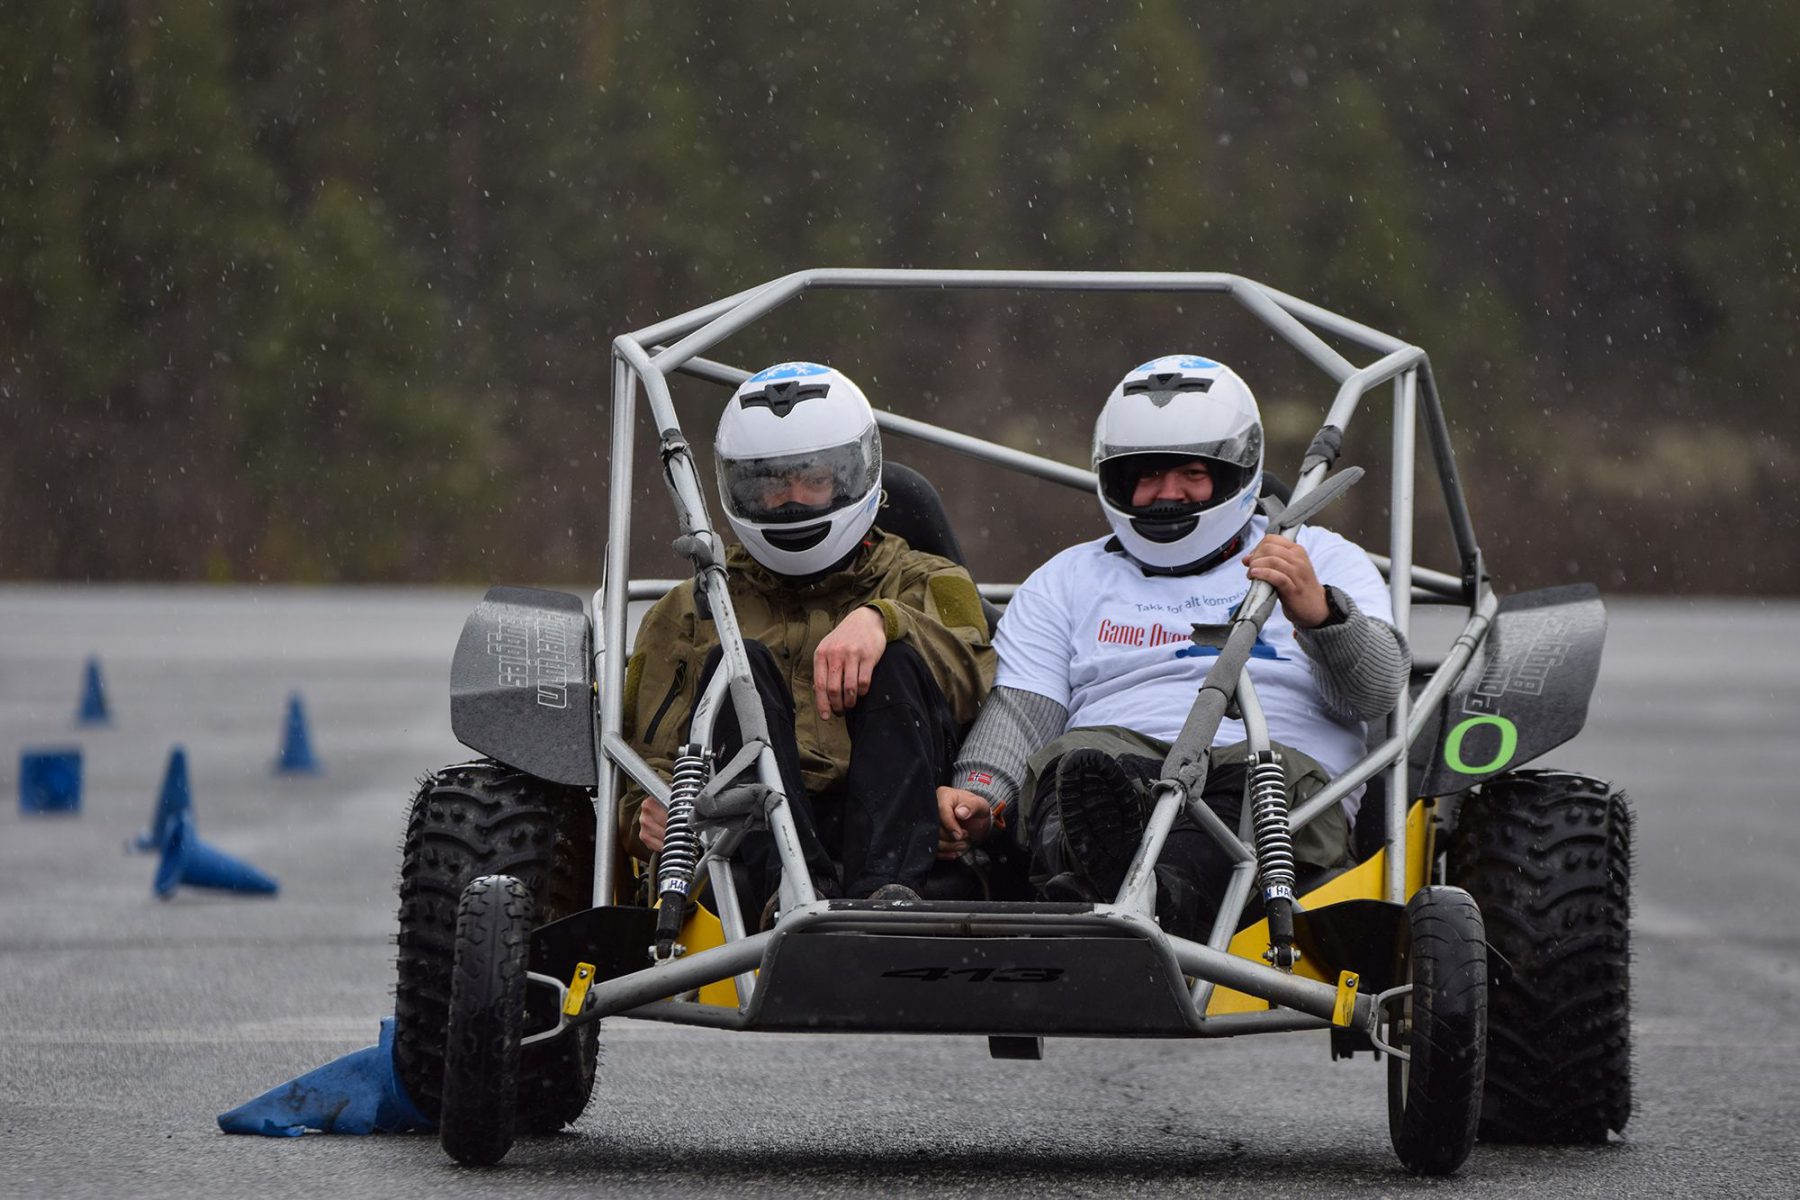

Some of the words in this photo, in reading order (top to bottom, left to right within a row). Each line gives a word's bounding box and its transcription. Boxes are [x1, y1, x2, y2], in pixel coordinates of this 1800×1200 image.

[1136, 603, 1164, 613] Takk
[1167, 604, 1183, 614] for
[1184, 596, 1200, 609] alt
[1098, 618, 1145, 647] Game
[879, 967, 1065, 983] 413
